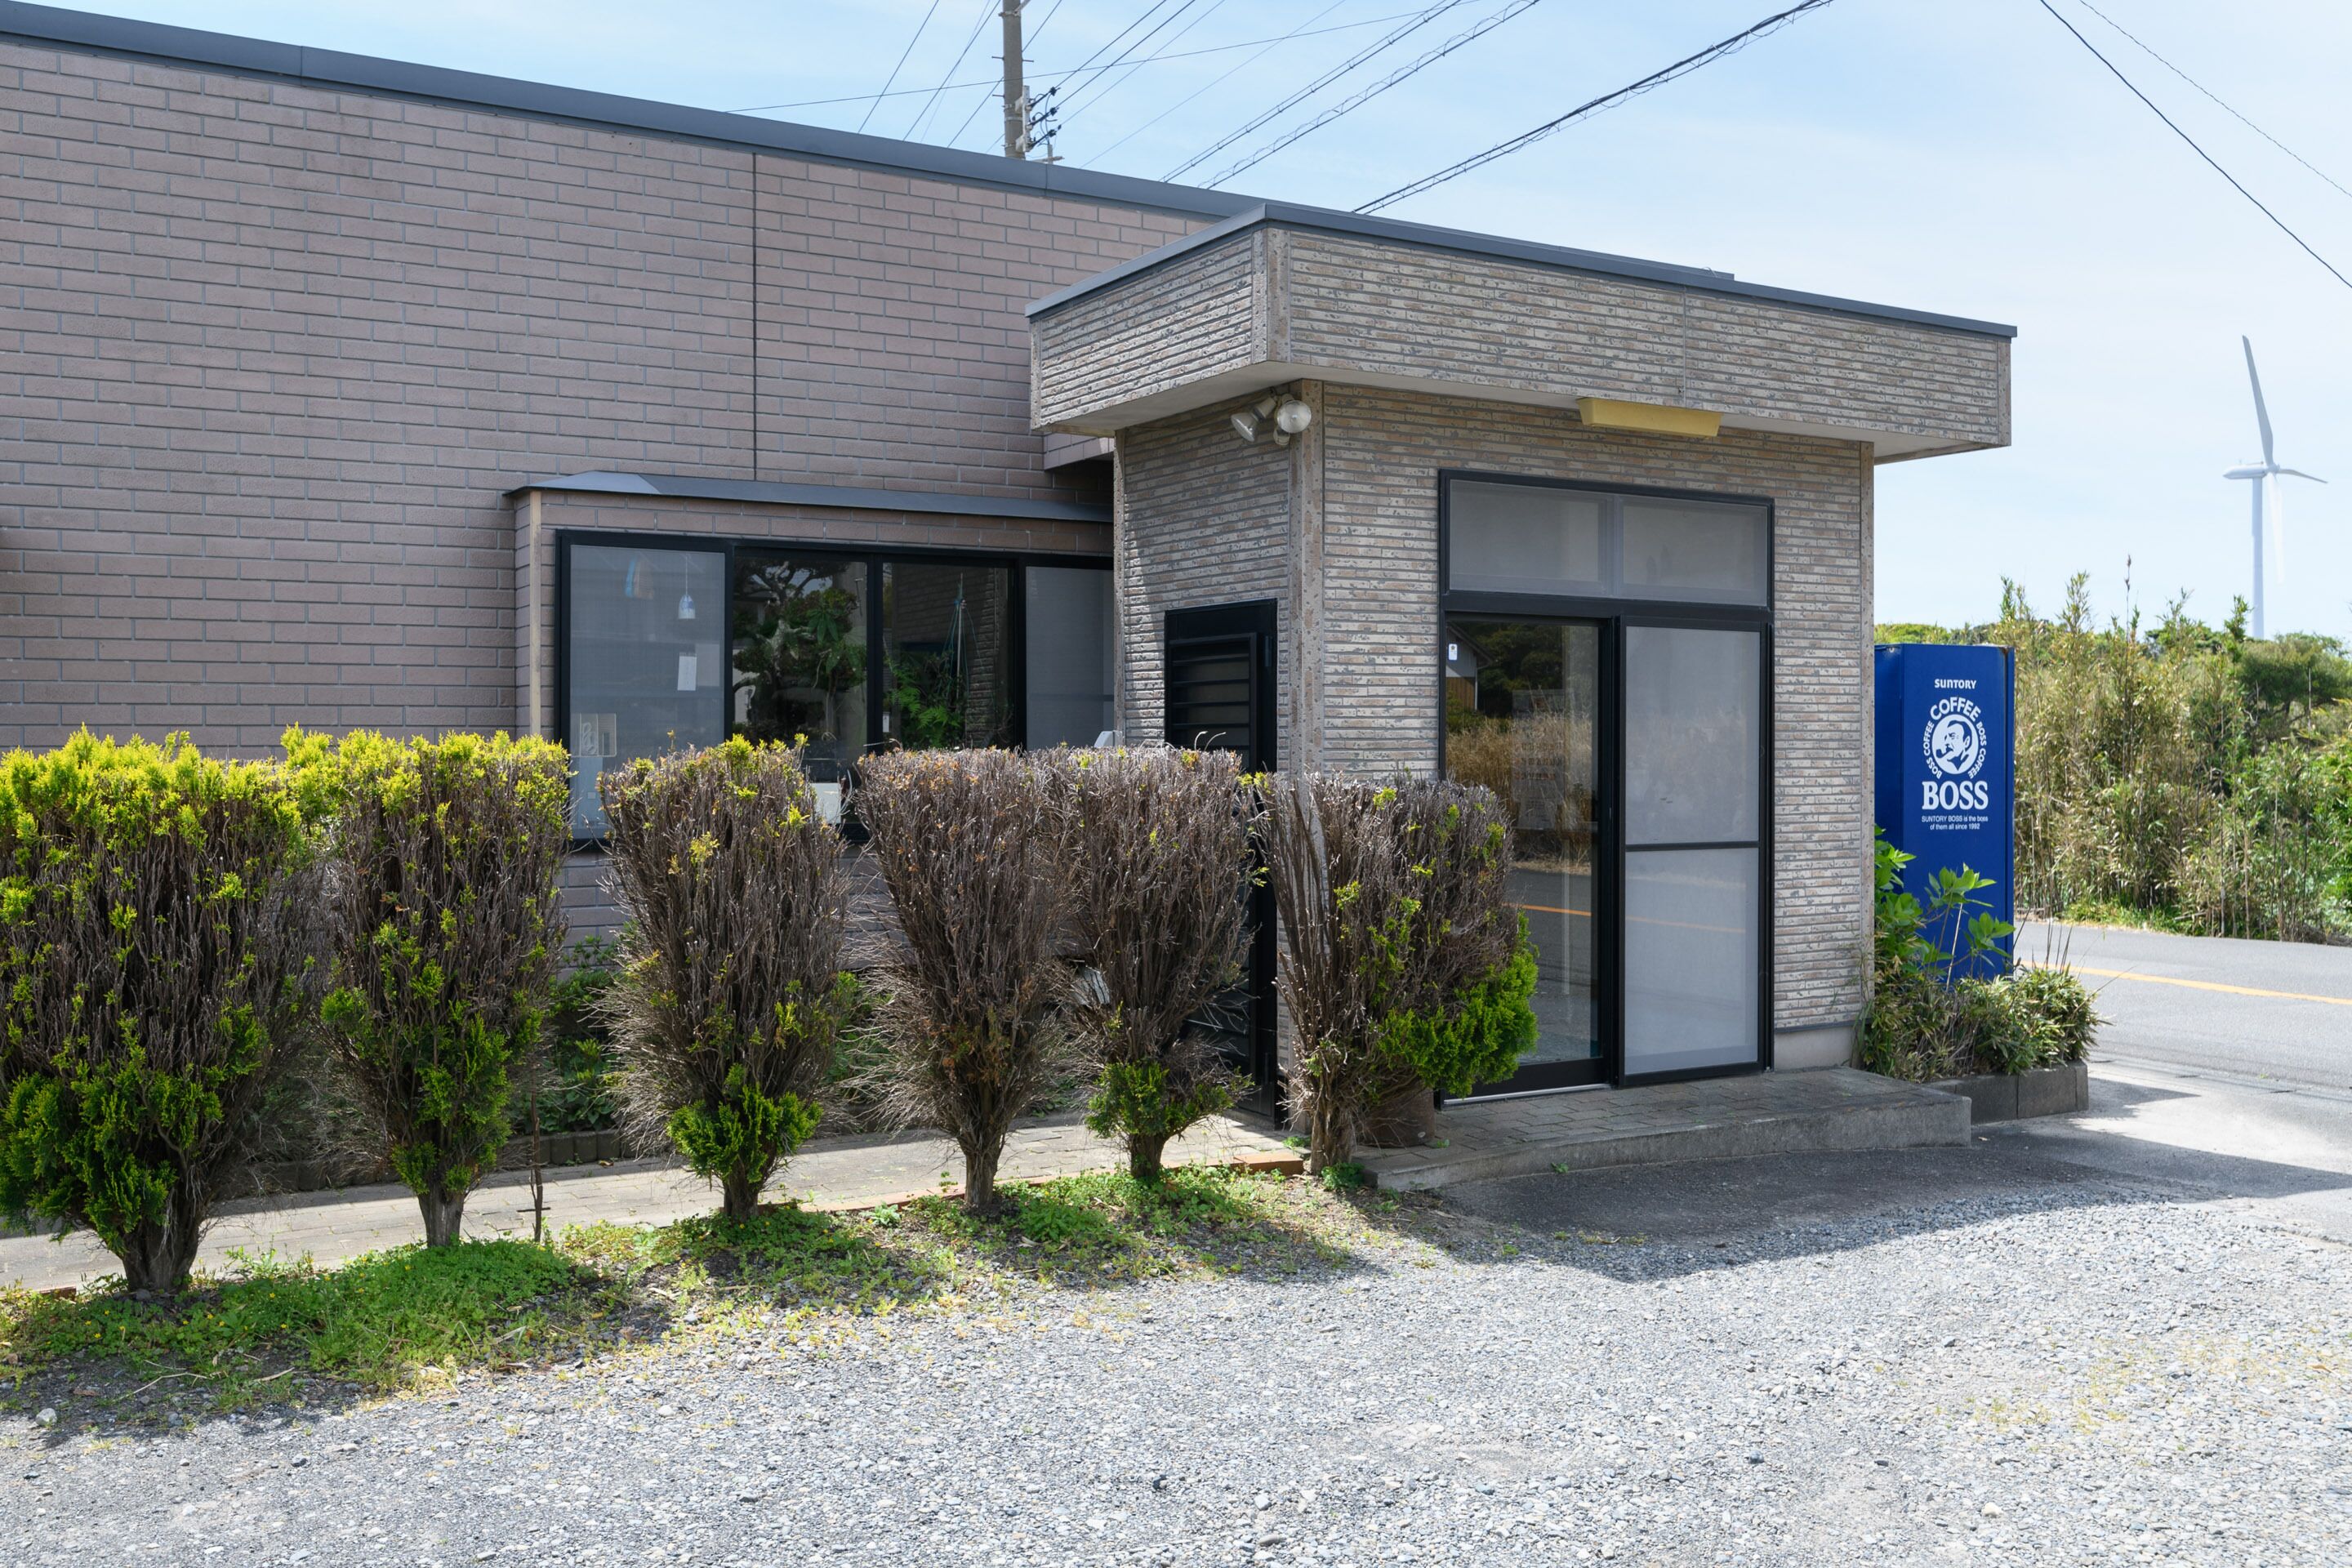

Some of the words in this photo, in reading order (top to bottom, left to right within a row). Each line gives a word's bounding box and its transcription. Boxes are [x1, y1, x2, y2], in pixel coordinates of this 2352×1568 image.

[1930, 697, 1981, 722] COFFEE
[1923, 720, 1935, 756] COFFEE
[1976, 721, 1987, 746] BOSS
[1926, 756, 1942, 779] BOSS
[1967, 747, 1986, 779] COFFEE
[1922, 780, 1989, 810] BOSS
